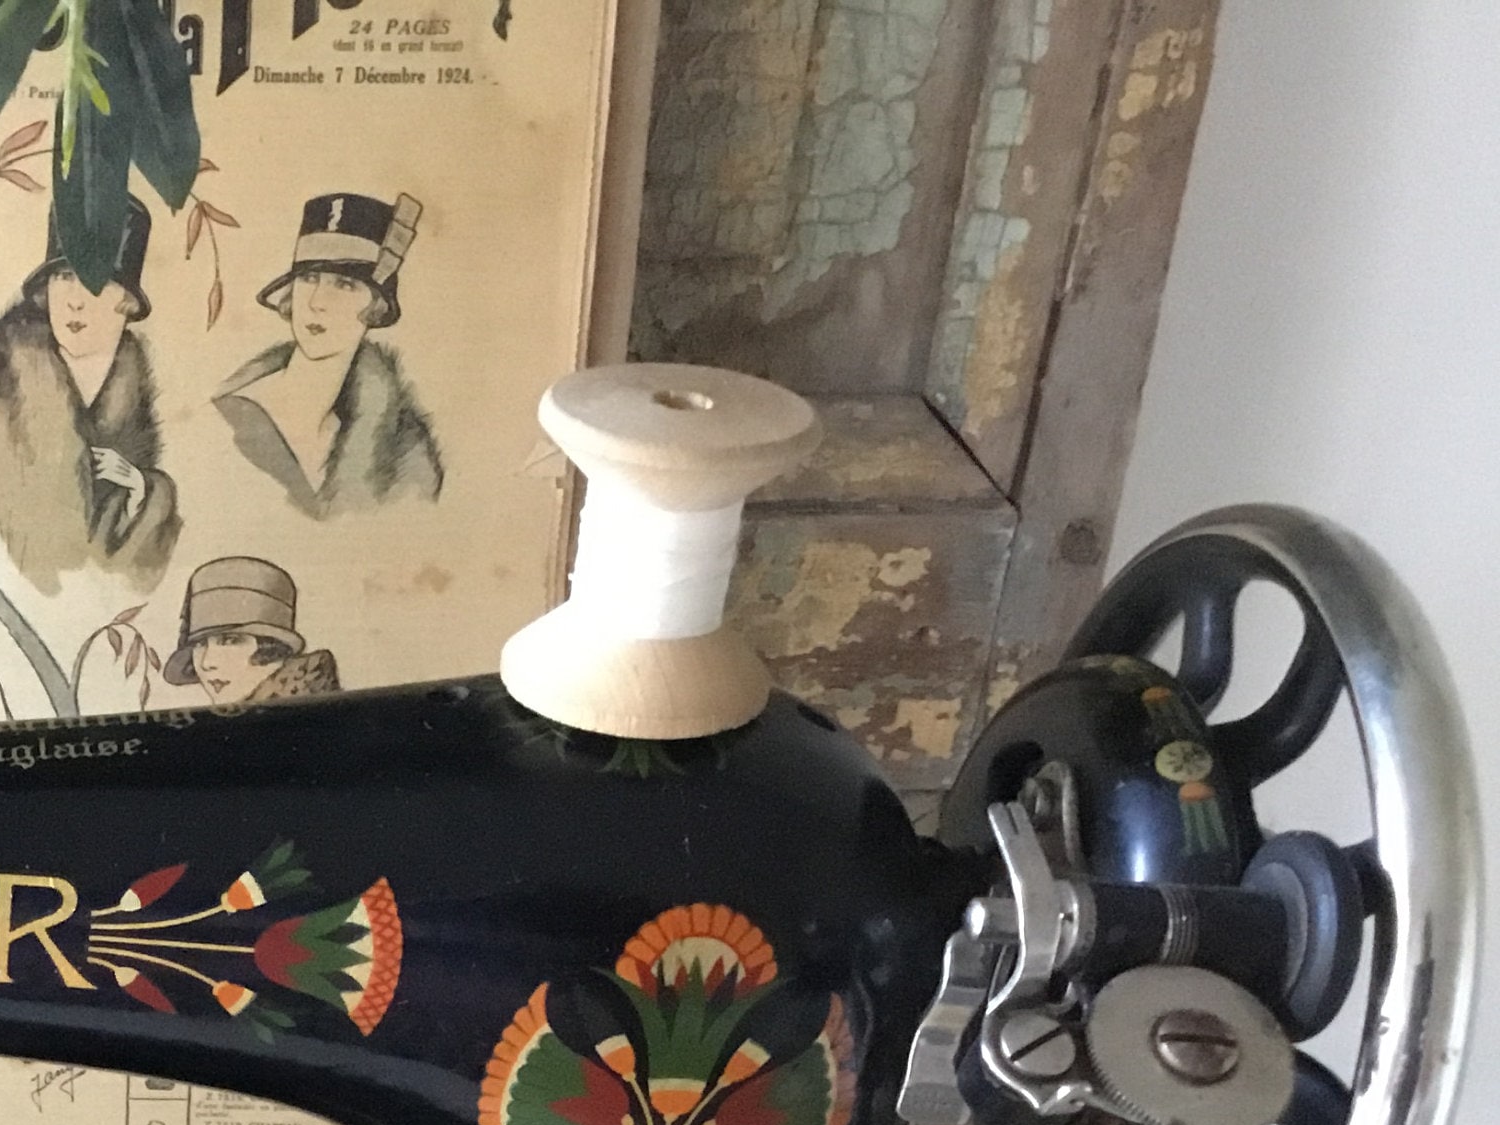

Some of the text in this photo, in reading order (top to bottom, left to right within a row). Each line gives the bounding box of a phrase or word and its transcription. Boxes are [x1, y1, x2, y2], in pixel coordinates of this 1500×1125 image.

[349, 18, 451, 35] 24 PAGES
[253, 65, 475, 84] Dimanche 7 Décembre 1924.
